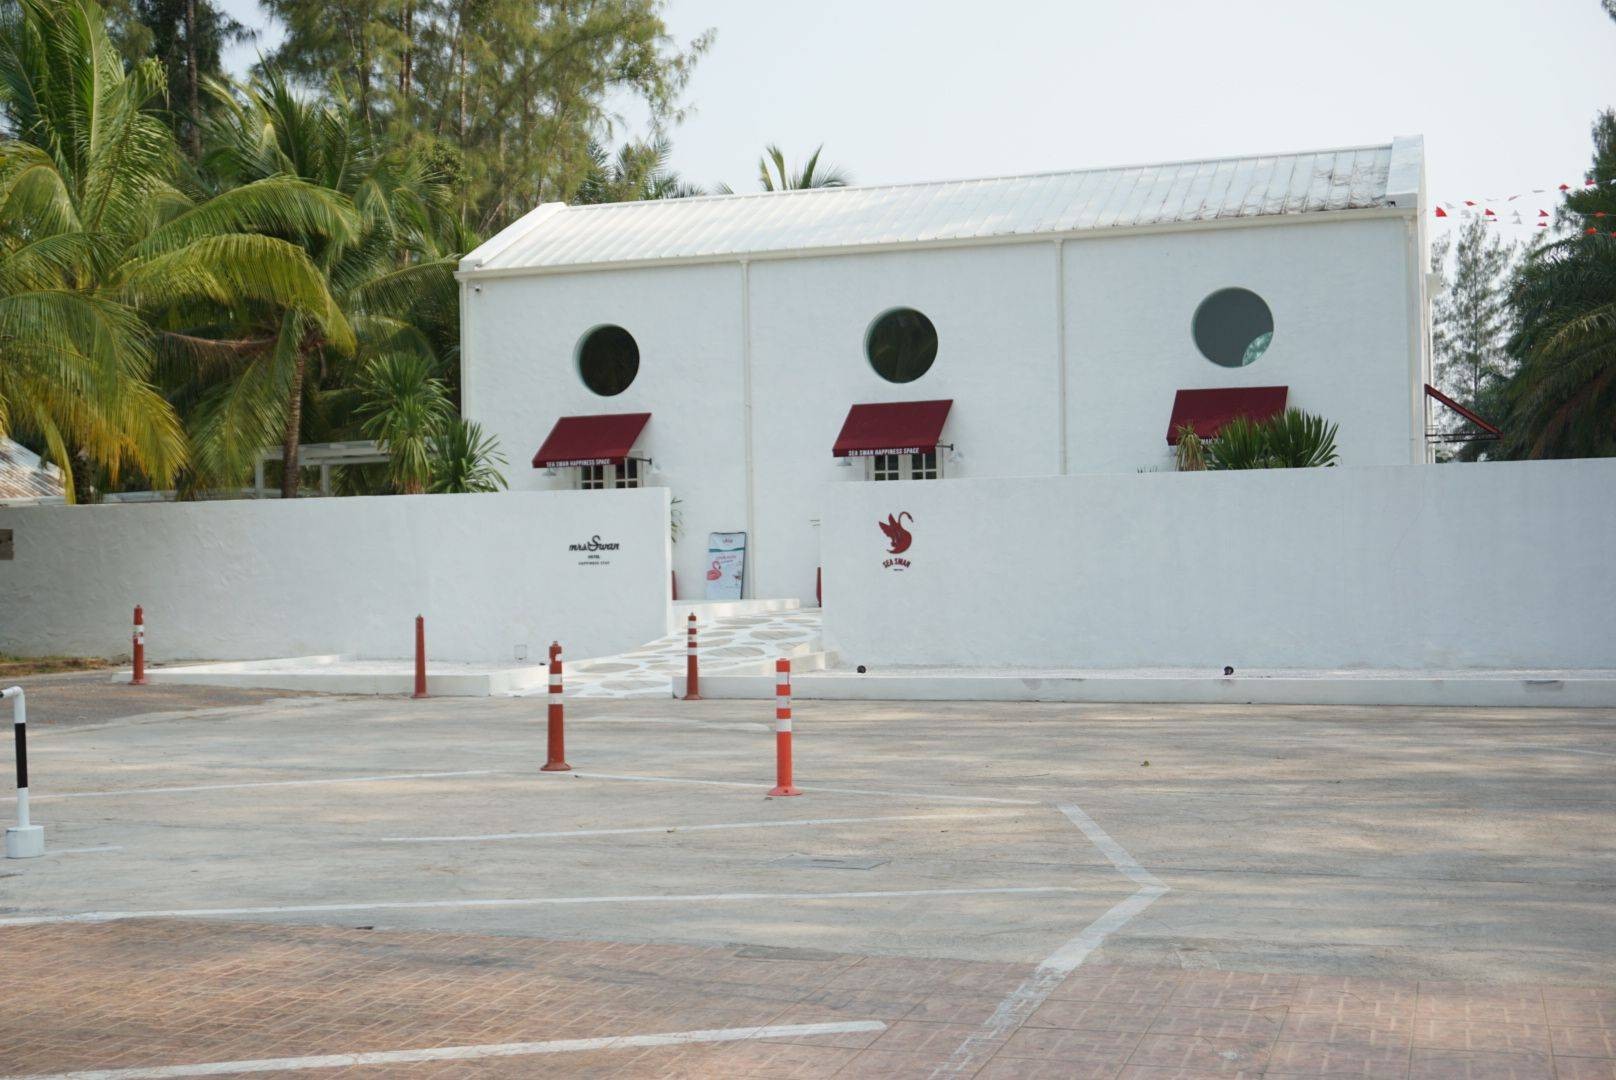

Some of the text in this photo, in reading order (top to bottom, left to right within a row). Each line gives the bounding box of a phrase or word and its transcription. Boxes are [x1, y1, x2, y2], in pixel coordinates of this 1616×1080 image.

[874, 447, 903, 456] HAPPINESS
[882, 557, 911, 568] SEA SWAN
